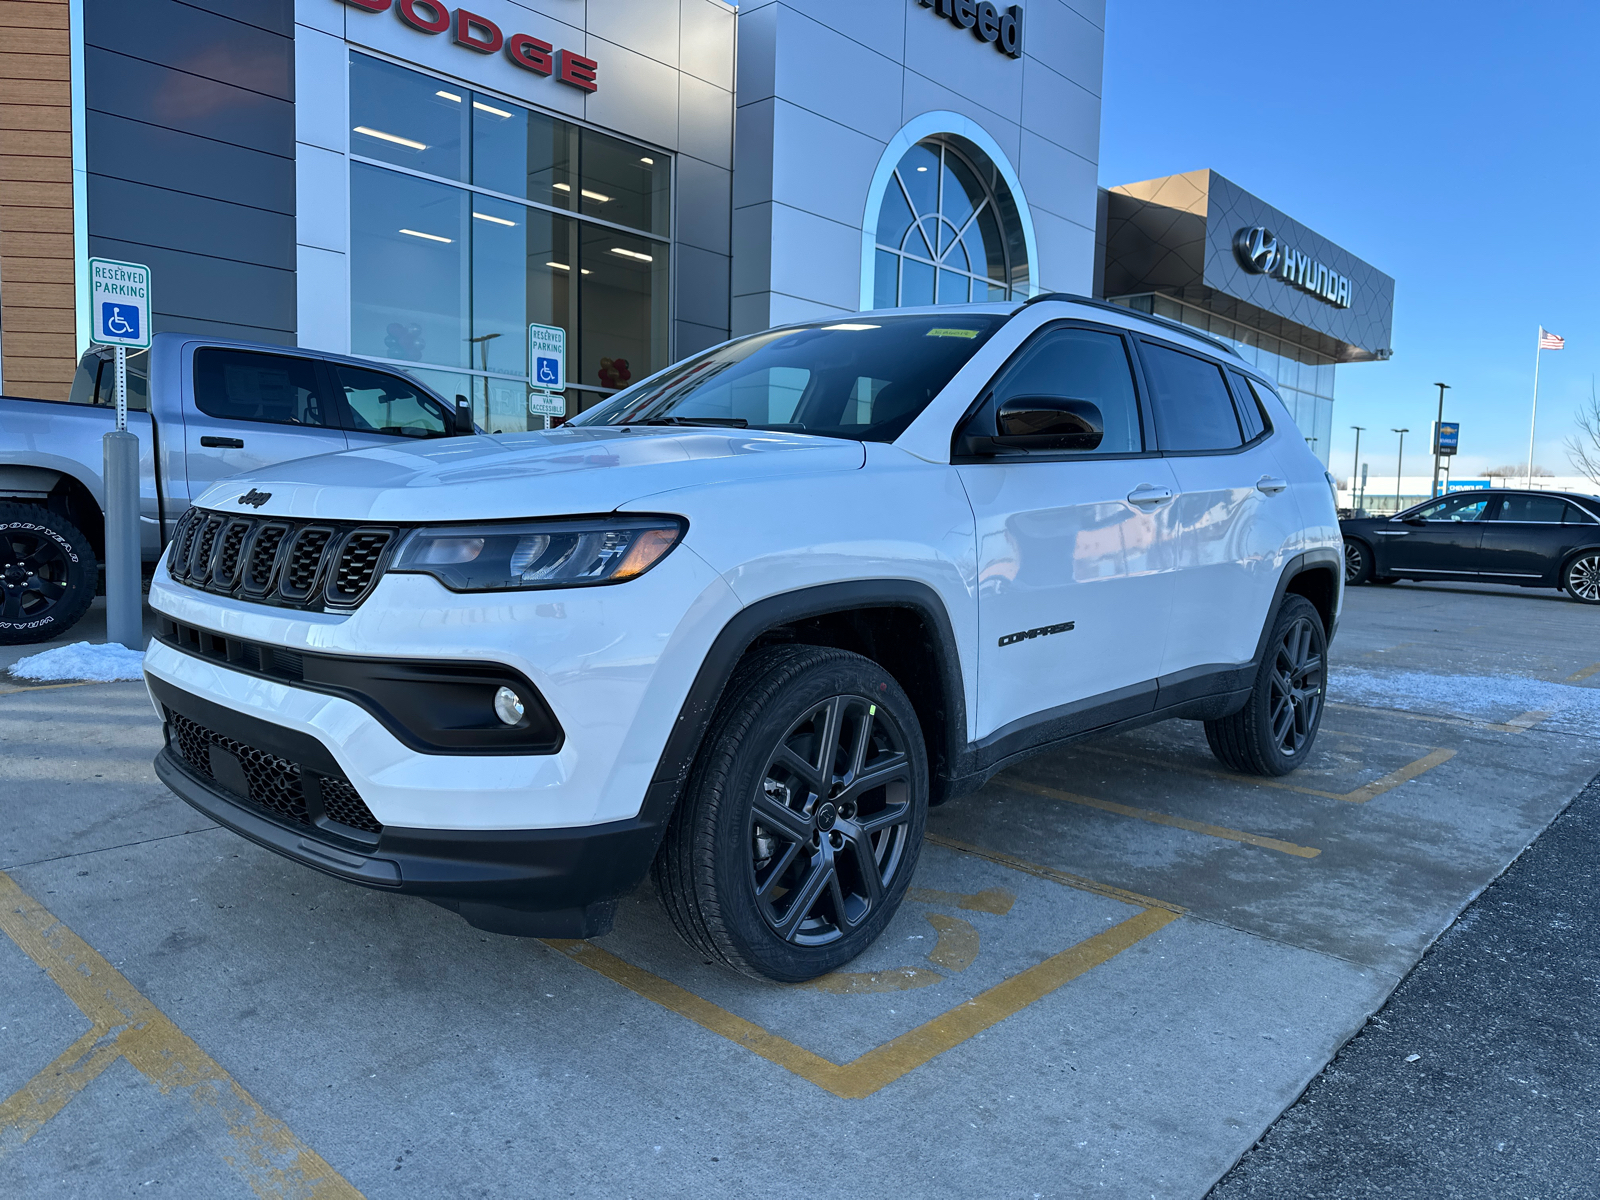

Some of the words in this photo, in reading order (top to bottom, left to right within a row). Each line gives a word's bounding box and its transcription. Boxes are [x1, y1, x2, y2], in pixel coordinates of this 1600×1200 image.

[918, 0, 1023, 59] eed
[335, 0, 598, 93] ODGE
[95, 266, 144, 284] RESERVED
[1281, 244, 1352, 309] HYUNDAI
[95, 281, 145, 298] PARKING
[533, 329, 562, 343] RESERVED
[533, 341, 562, 354] PARKING
[533, 404, 563, 412] ACCESSIBLE
[237, 487, 273, 510] Jeep
[998, 620, 1076, 648] COMPASS
